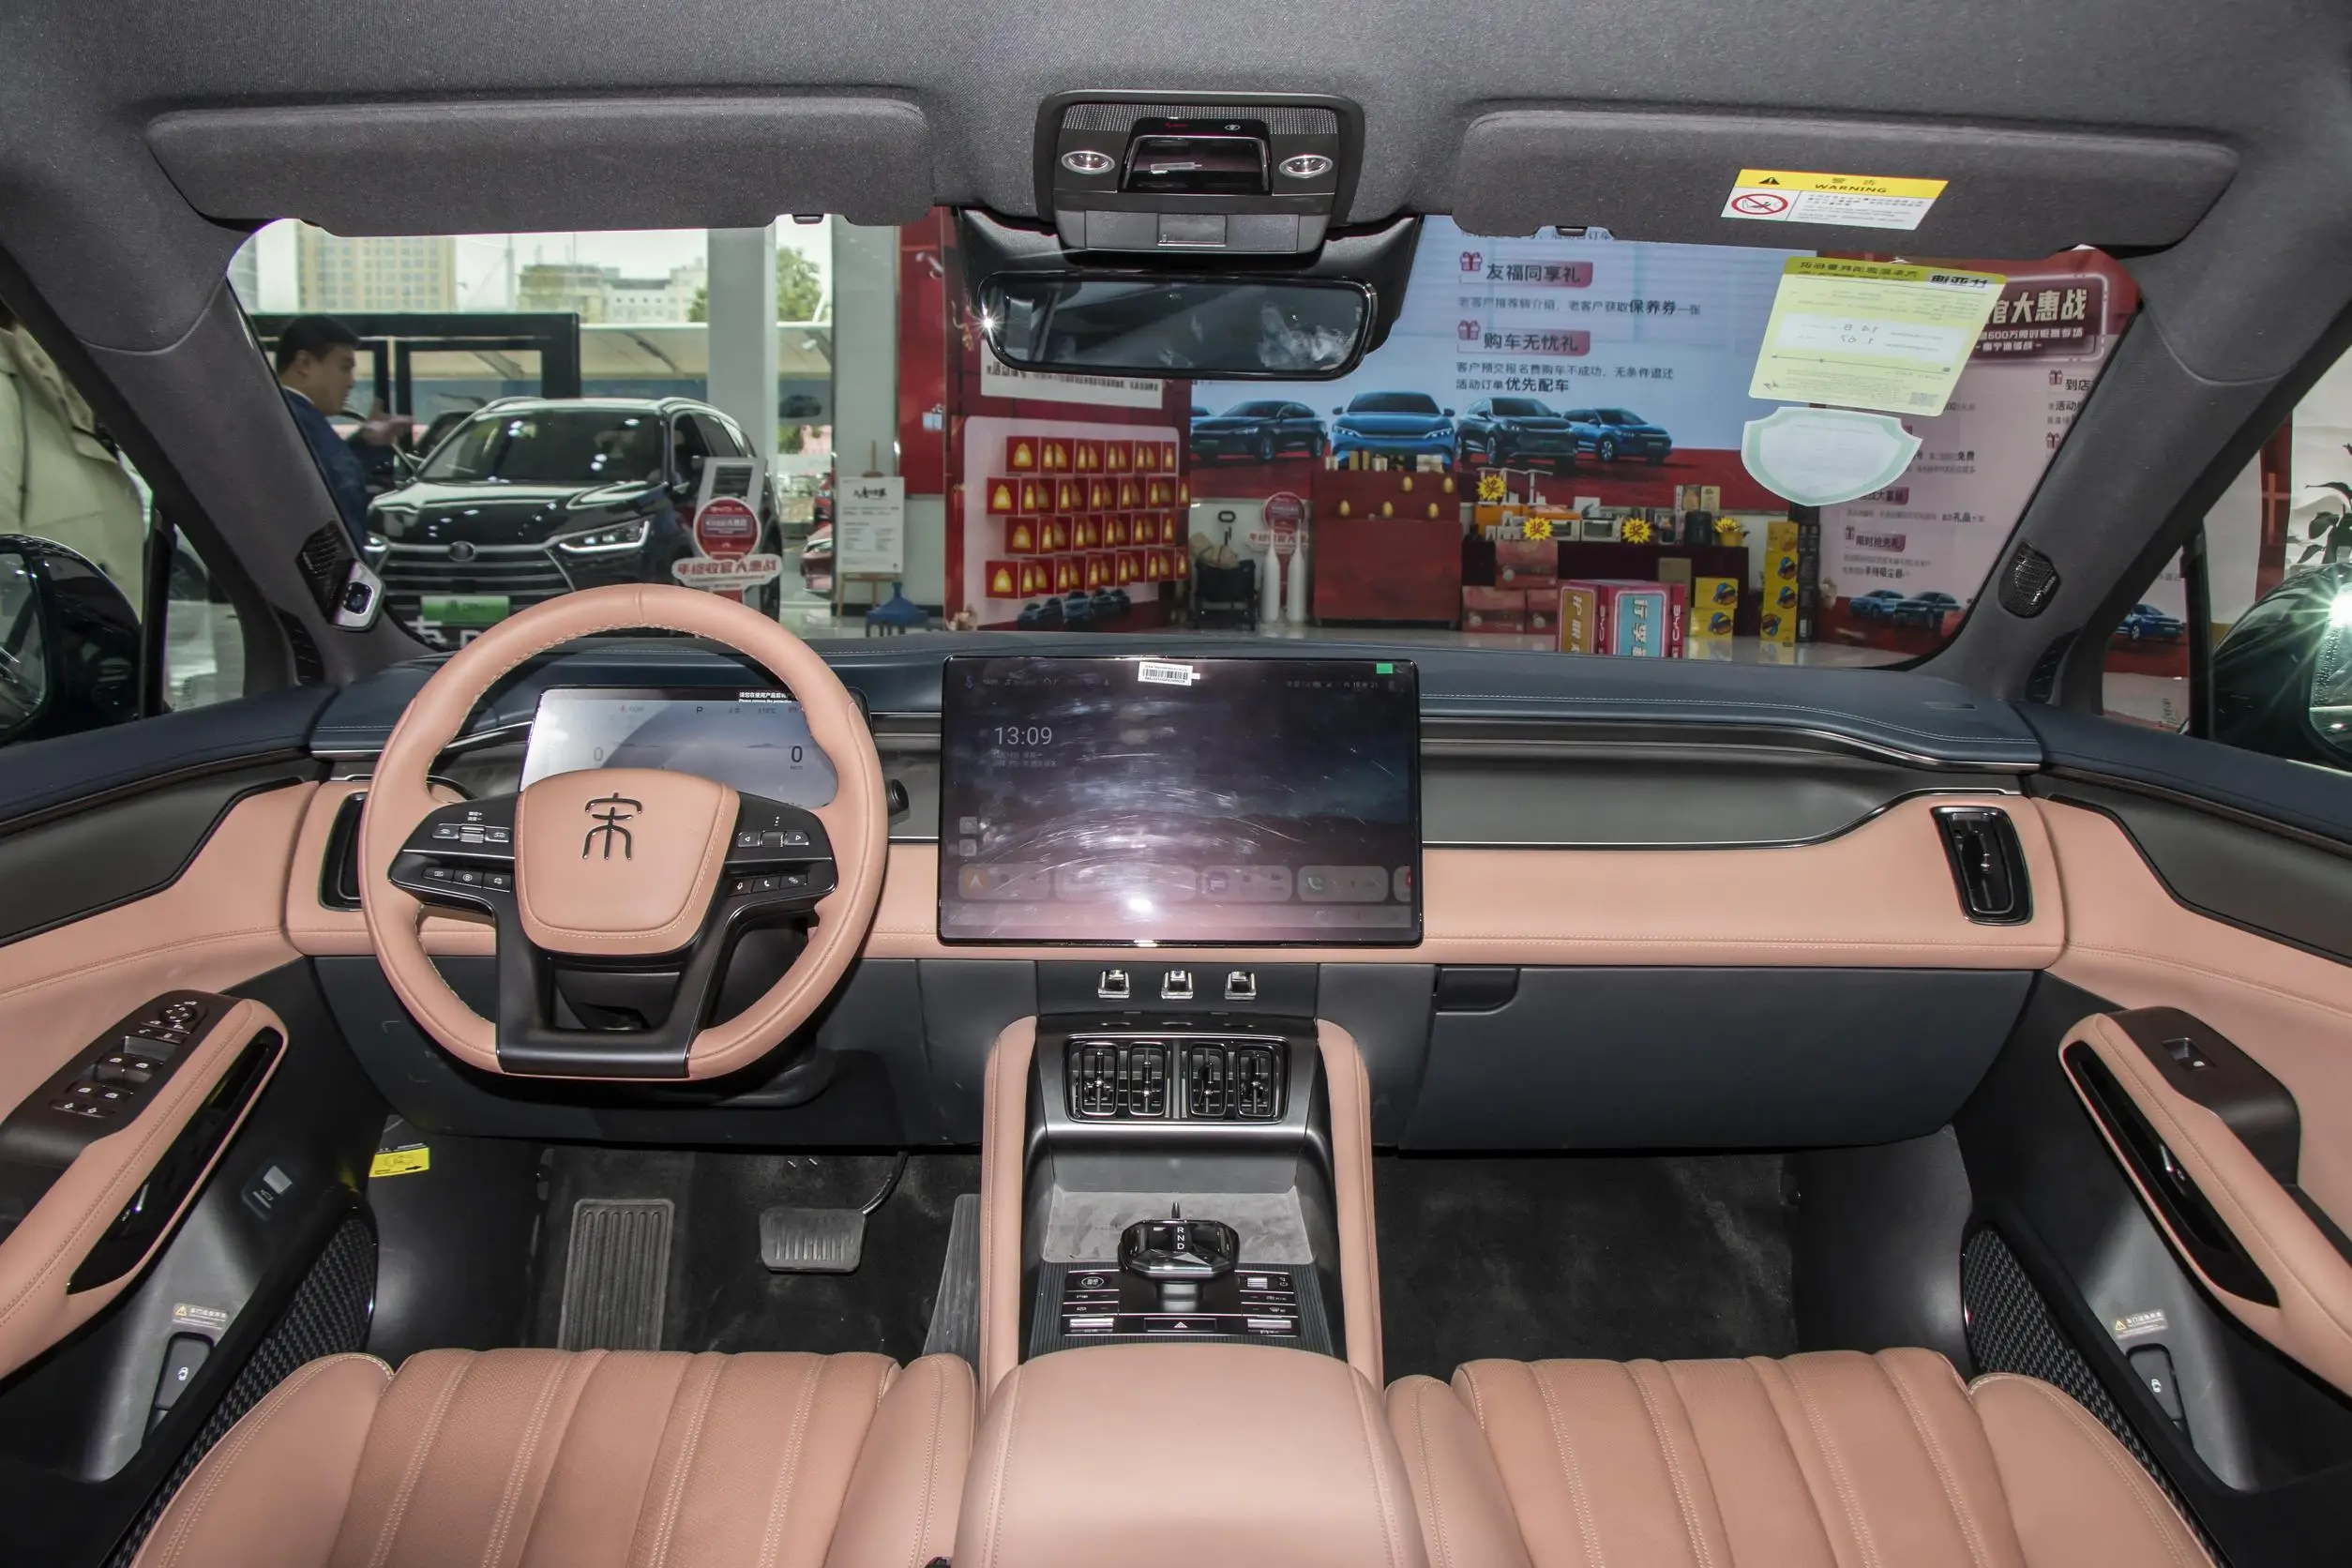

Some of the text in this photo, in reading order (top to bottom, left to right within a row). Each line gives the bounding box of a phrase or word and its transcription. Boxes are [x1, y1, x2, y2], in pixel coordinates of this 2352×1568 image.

[1815, 184, 1887, 193] WARNING
[1486, 263, 1581, 283] 友福同享礼
[1987, 289, 2088, 324] 官大惠战
[1484, 332, 1579, 352] 购车无忧礼
[1455, 378, 1570, 393] 活动订单优先配车
[2065, 378, 2093, 391] 到店
[1672, 604, 1681, 641] BYD
[994, 726, 1052, 746] 13:09
[791, 746, 803, 763] 0
